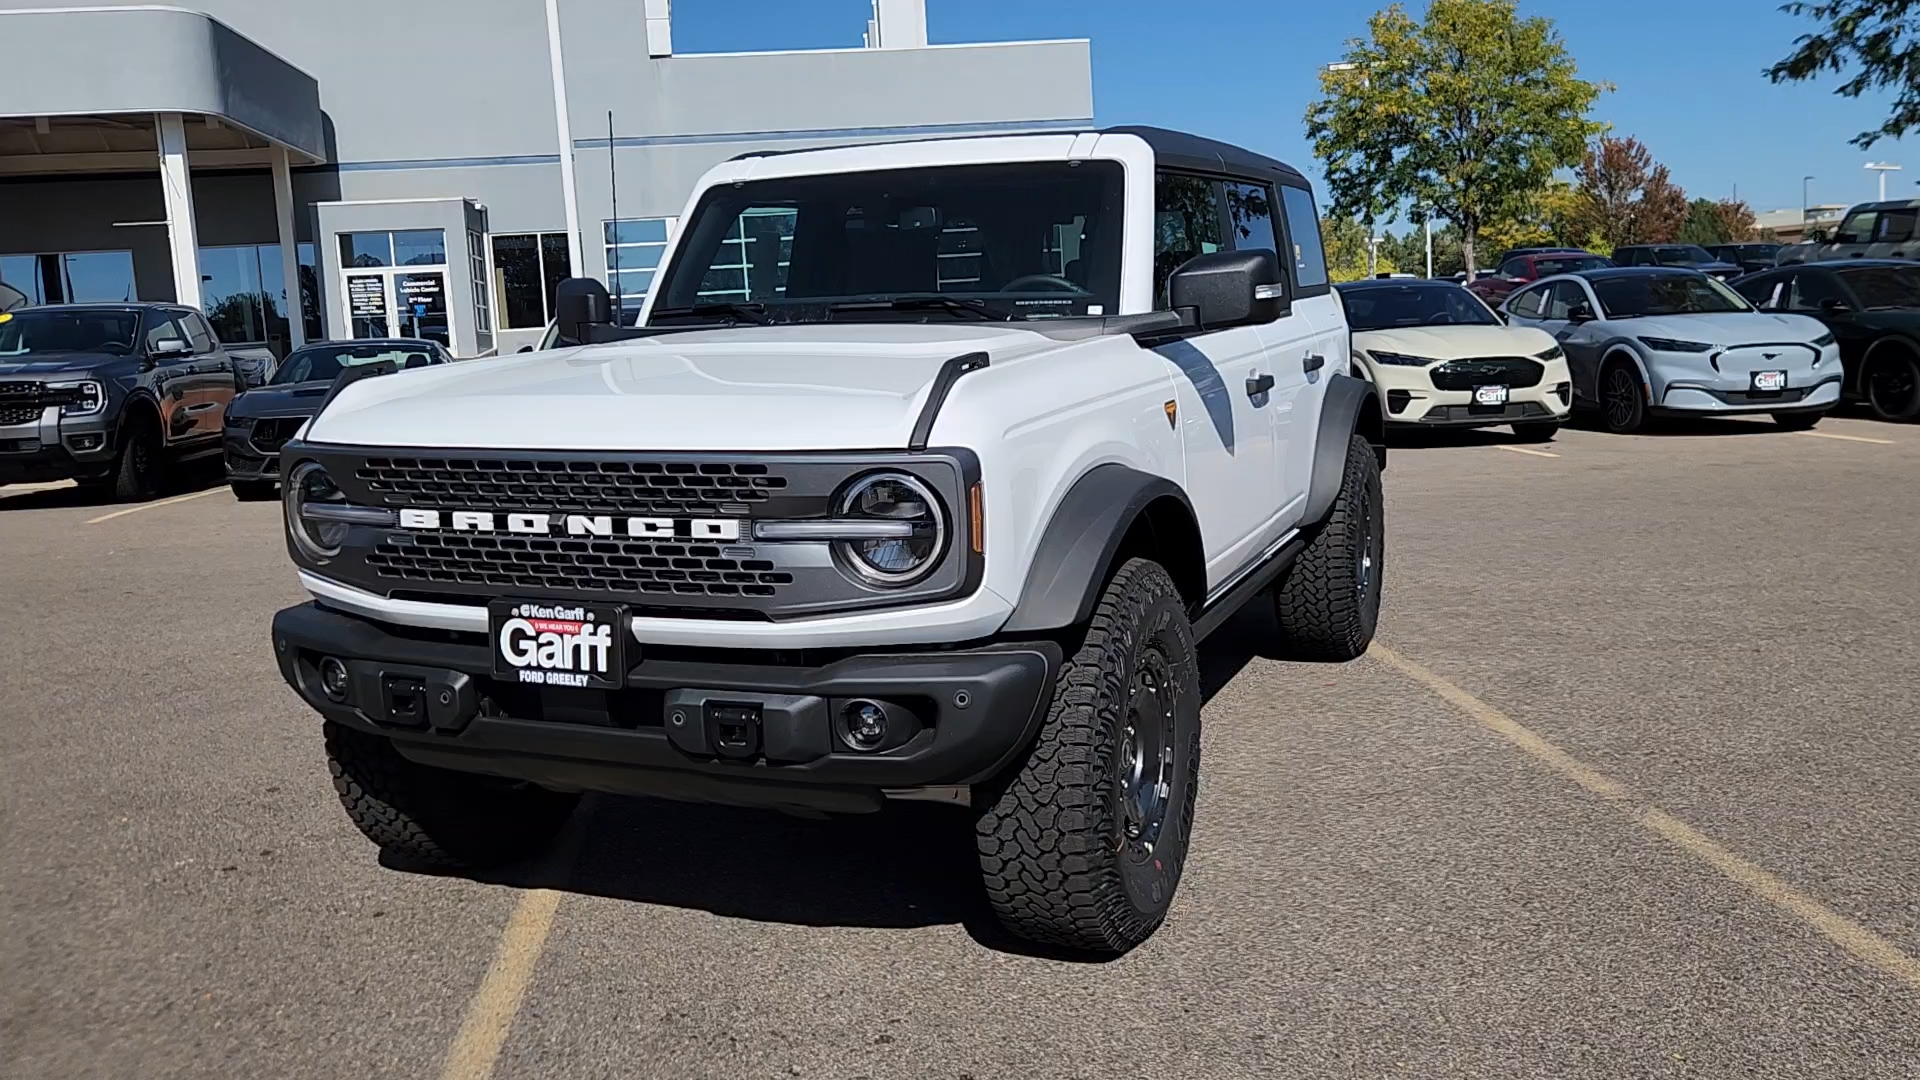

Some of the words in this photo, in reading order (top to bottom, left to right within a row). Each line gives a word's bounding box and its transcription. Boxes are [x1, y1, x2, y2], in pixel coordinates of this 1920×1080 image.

[1476, 388, 1507, 401] Garff
[400, 508, 740, 539] BRONCO
[531, 604, 554, 619] Ken
[554, 606, 584, 620] Garff
[500, 618, 611, 672] Garff
[519, 671, 544, 684] FORD
[546, 673, 588, 687] GREELEY
